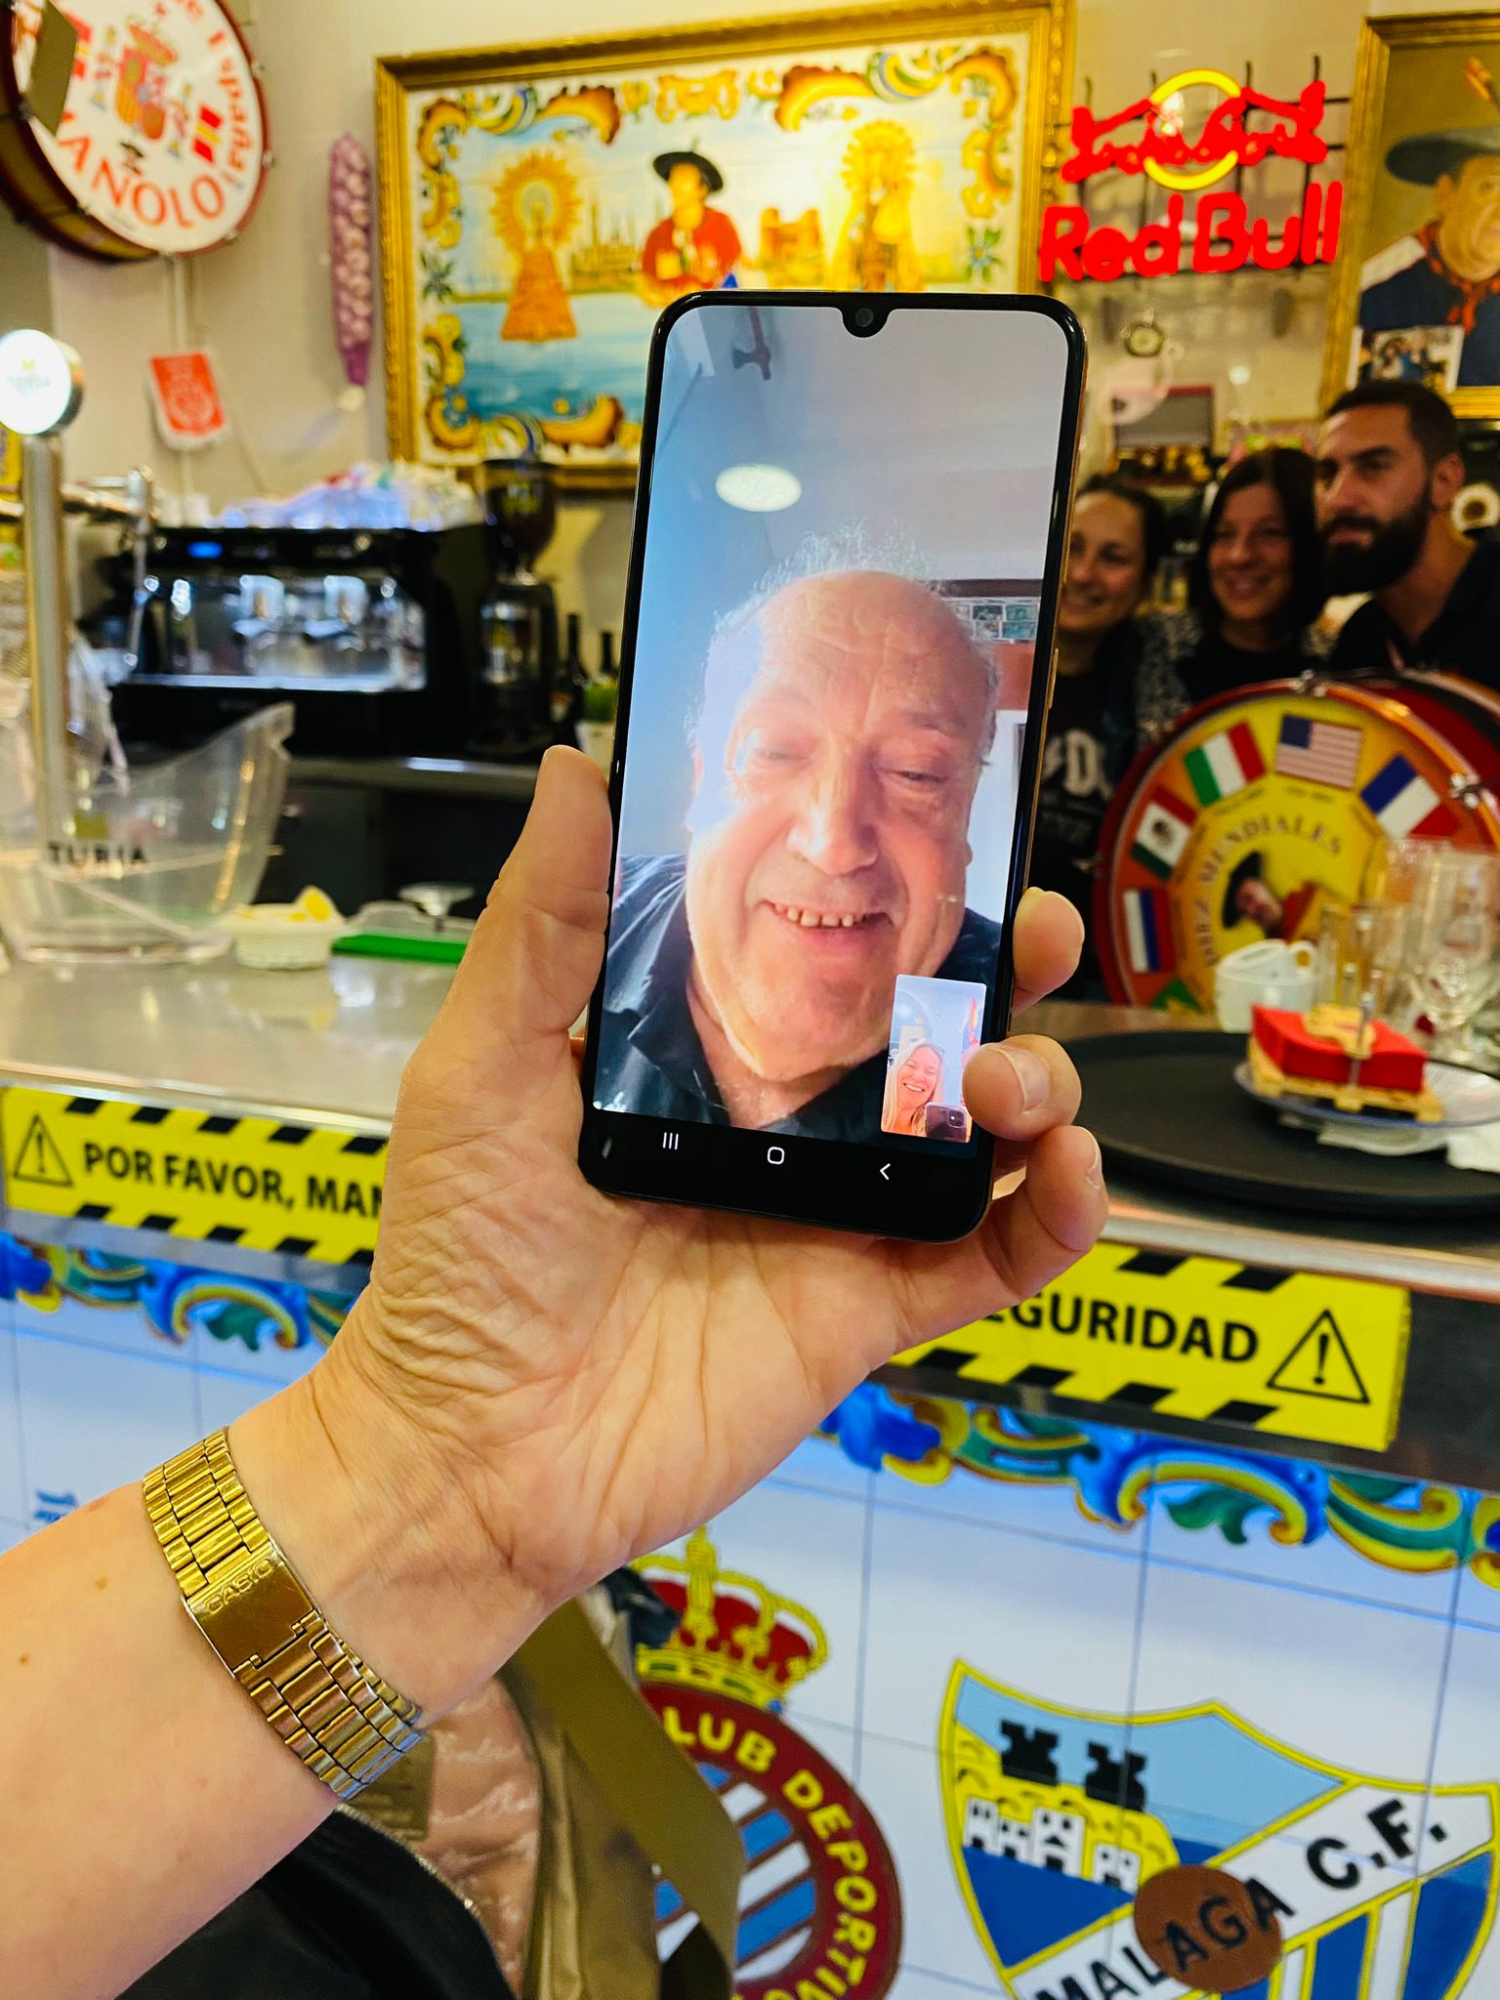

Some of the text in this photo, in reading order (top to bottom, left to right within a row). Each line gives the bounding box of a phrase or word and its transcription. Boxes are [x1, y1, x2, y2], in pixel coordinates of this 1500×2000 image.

[58, 110, 225, 228] ANOLO
[1040, 180, 1343, 282] Red Bull
[83, 1142, 155, 1185] POR
[162, 1153, 295, 1212] FAVOR,
[984, 1291, 1260, 1364] GURIDAD
[203, 1558, 275, 1616] CASIO
[1306, 1798, 1448, 1890] C.F.
